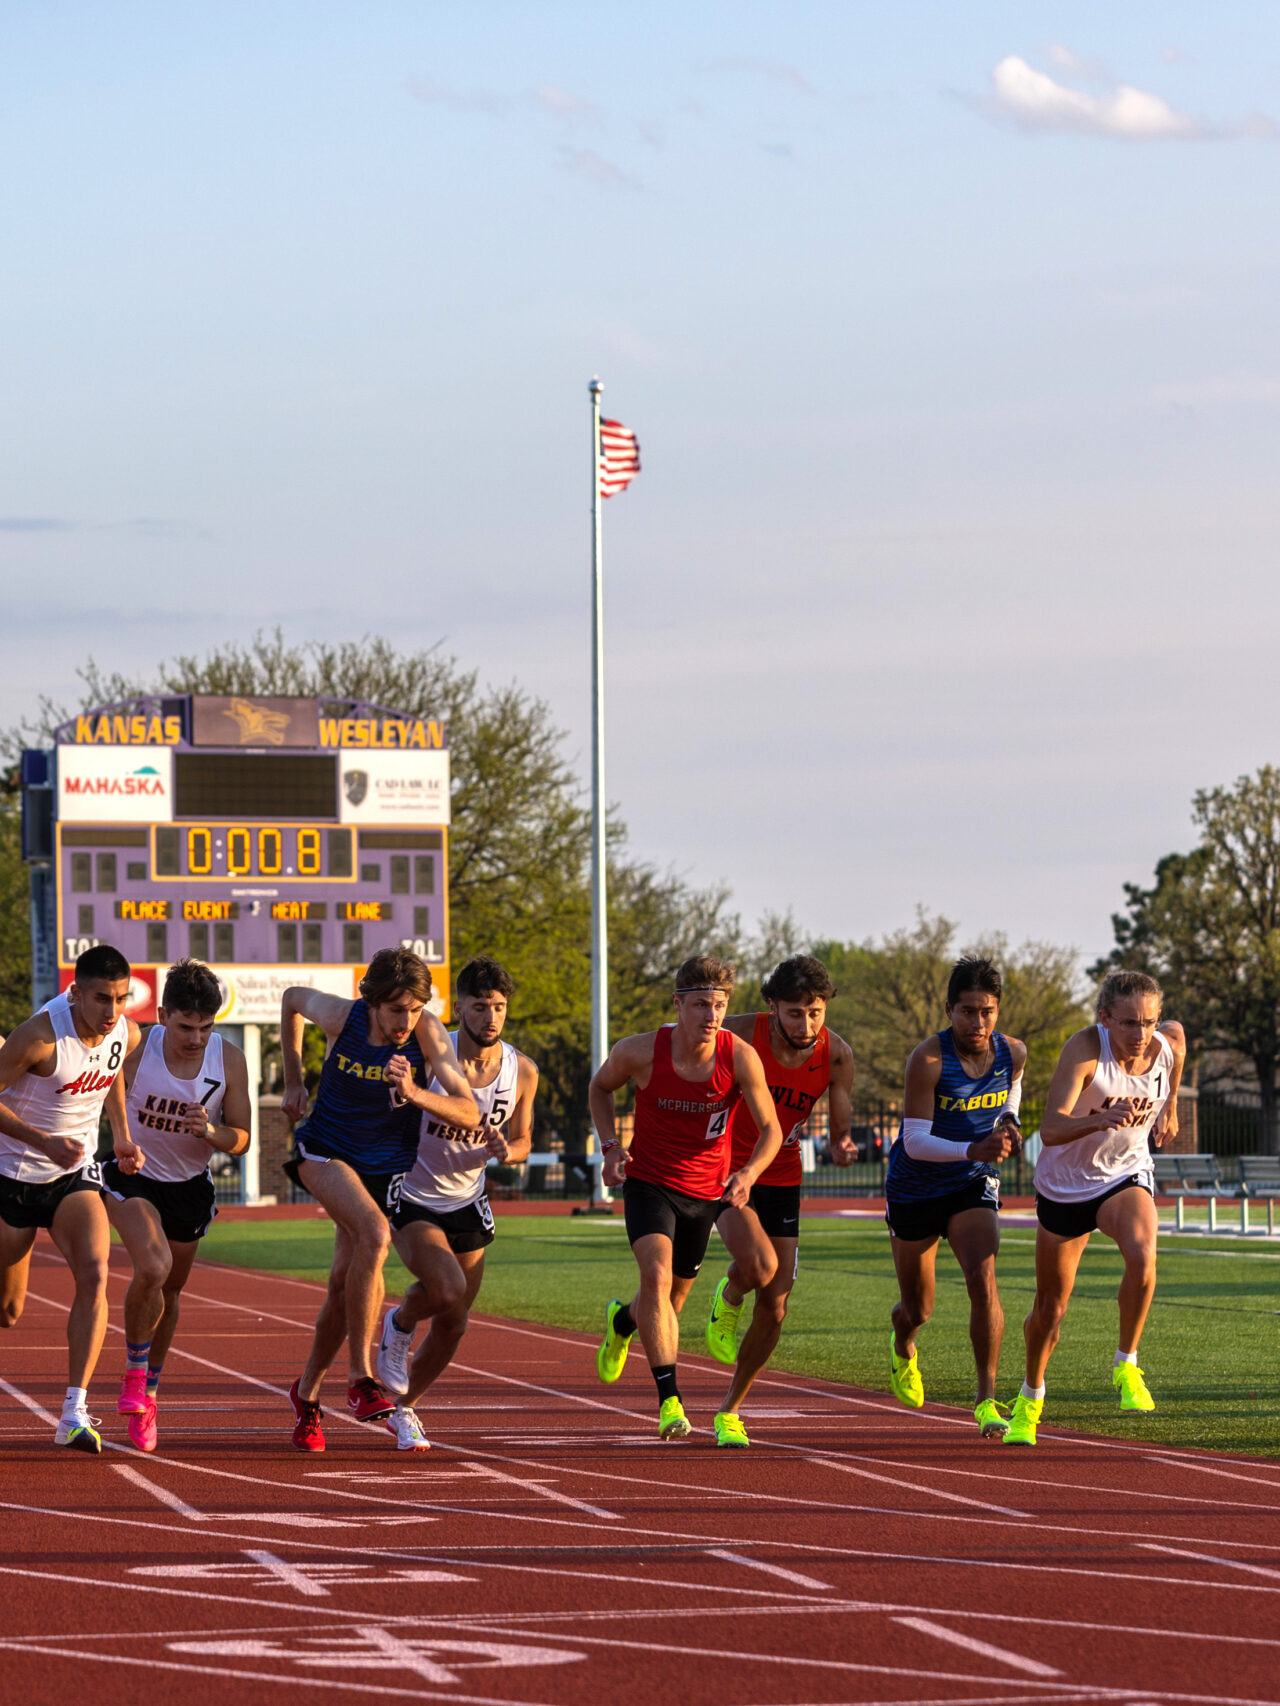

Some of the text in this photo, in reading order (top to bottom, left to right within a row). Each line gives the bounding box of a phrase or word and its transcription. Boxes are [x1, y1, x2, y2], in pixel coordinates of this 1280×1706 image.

[75, 715, 445, 748] KANSAS WESLEYAN
[65, 777, 165, 795] MAHASKA
[187, 827, 321, 874] 0:00.8
[121, 900, 382, 921] PLACE EVENT HEAT LANE
[107, 1041, 122, 1070] 8
[336, 1053, 417, 1082] TAB
[55, 1069, 116, 1095] Allen
[200, 1077, 221, 1106] 7
[1154, 1072, 1162, 1098] 1
[145, 1094, 188, 1117] KANS
[489, 1099, 508, 1126] 5
[657, 1097, 726, 1113] MCPHERSON
[938, 1089, 1008, 1112] TABOR
[137, 1110, 194, 1134] WESLE
[426, 1120, 488, 1144] WESLEYA
[710, 1111, 726, 1136] 4
